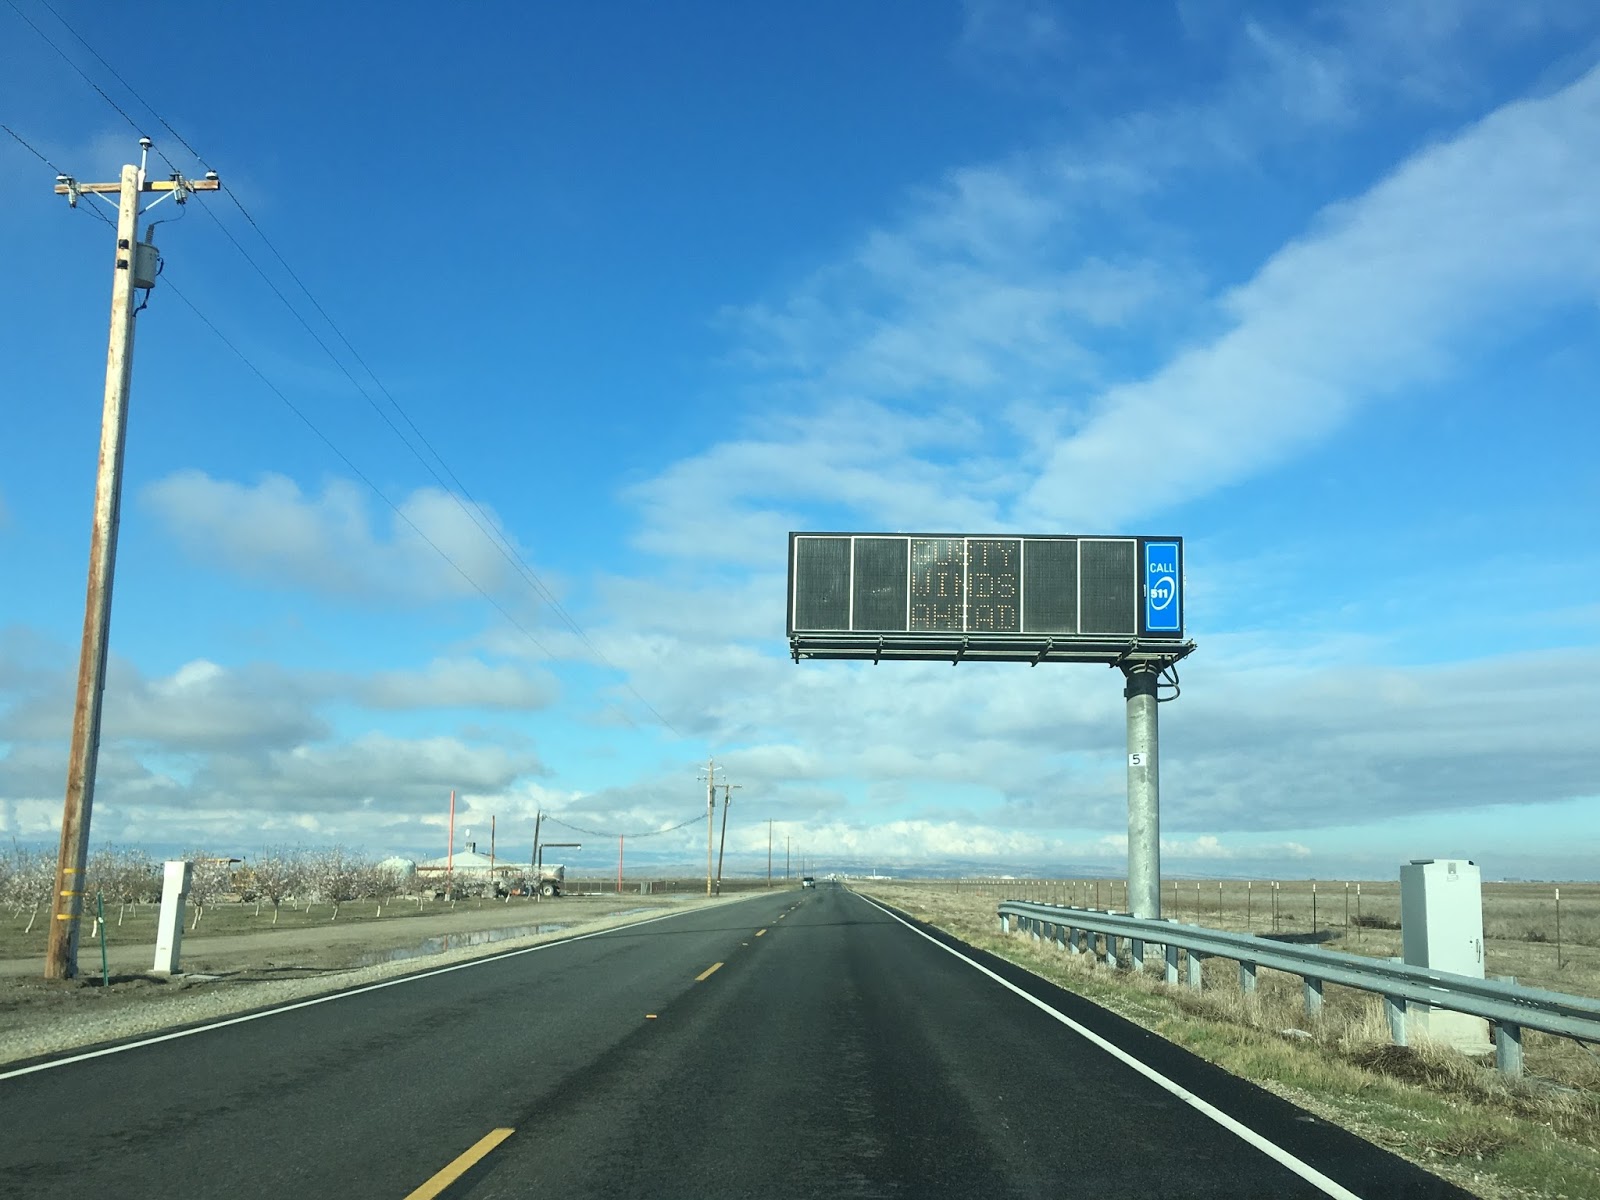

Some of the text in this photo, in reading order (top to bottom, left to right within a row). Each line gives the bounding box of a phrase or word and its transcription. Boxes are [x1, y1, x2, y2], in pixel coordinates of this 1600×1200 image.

[912, 541, 1016, 567] GUSTY
[1149, 562, 1175, 574] CALL
[912, 572, 1016, 598] WINDS
[1150, 588, 1169, 599] 511
[911, 603, 1016, 629] AHEAD
[1132, 753, 1141, 765] 5
